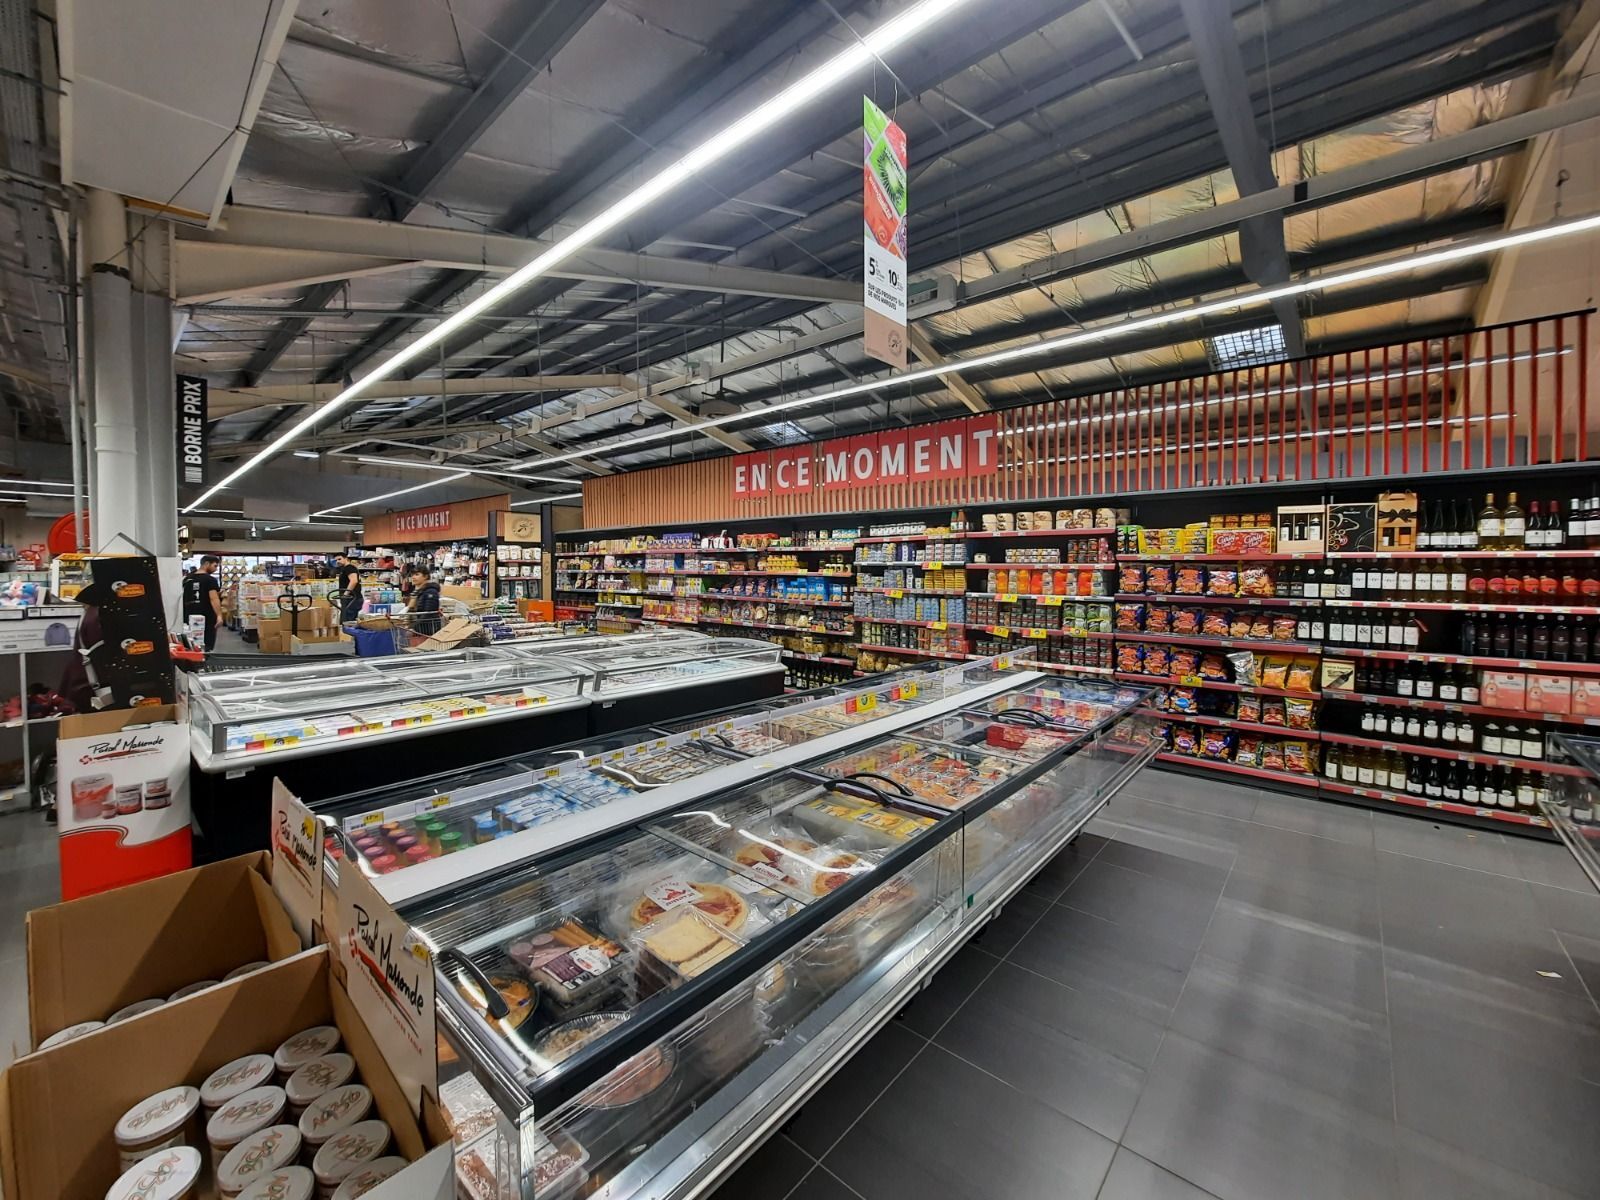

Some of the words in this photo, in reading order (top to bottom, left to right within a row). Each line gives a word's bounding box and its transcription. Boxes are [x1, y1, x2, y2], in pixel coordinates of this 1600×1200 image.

[869, 257, 875, 276] 5
[888, 269, 898, 286] 10
[183, 380, 202, 415] PRIX
[183, 416, 203, 465] BORNE
[735, 463, 767, 493] EN
[776, 456, 810, 488] CE
[826, 429, 994, 483] MOMENT
[396, 518, 405, 531] EN
[406, 516, 415, 530] CE
[417, 511, 450, 529] MOMENT
